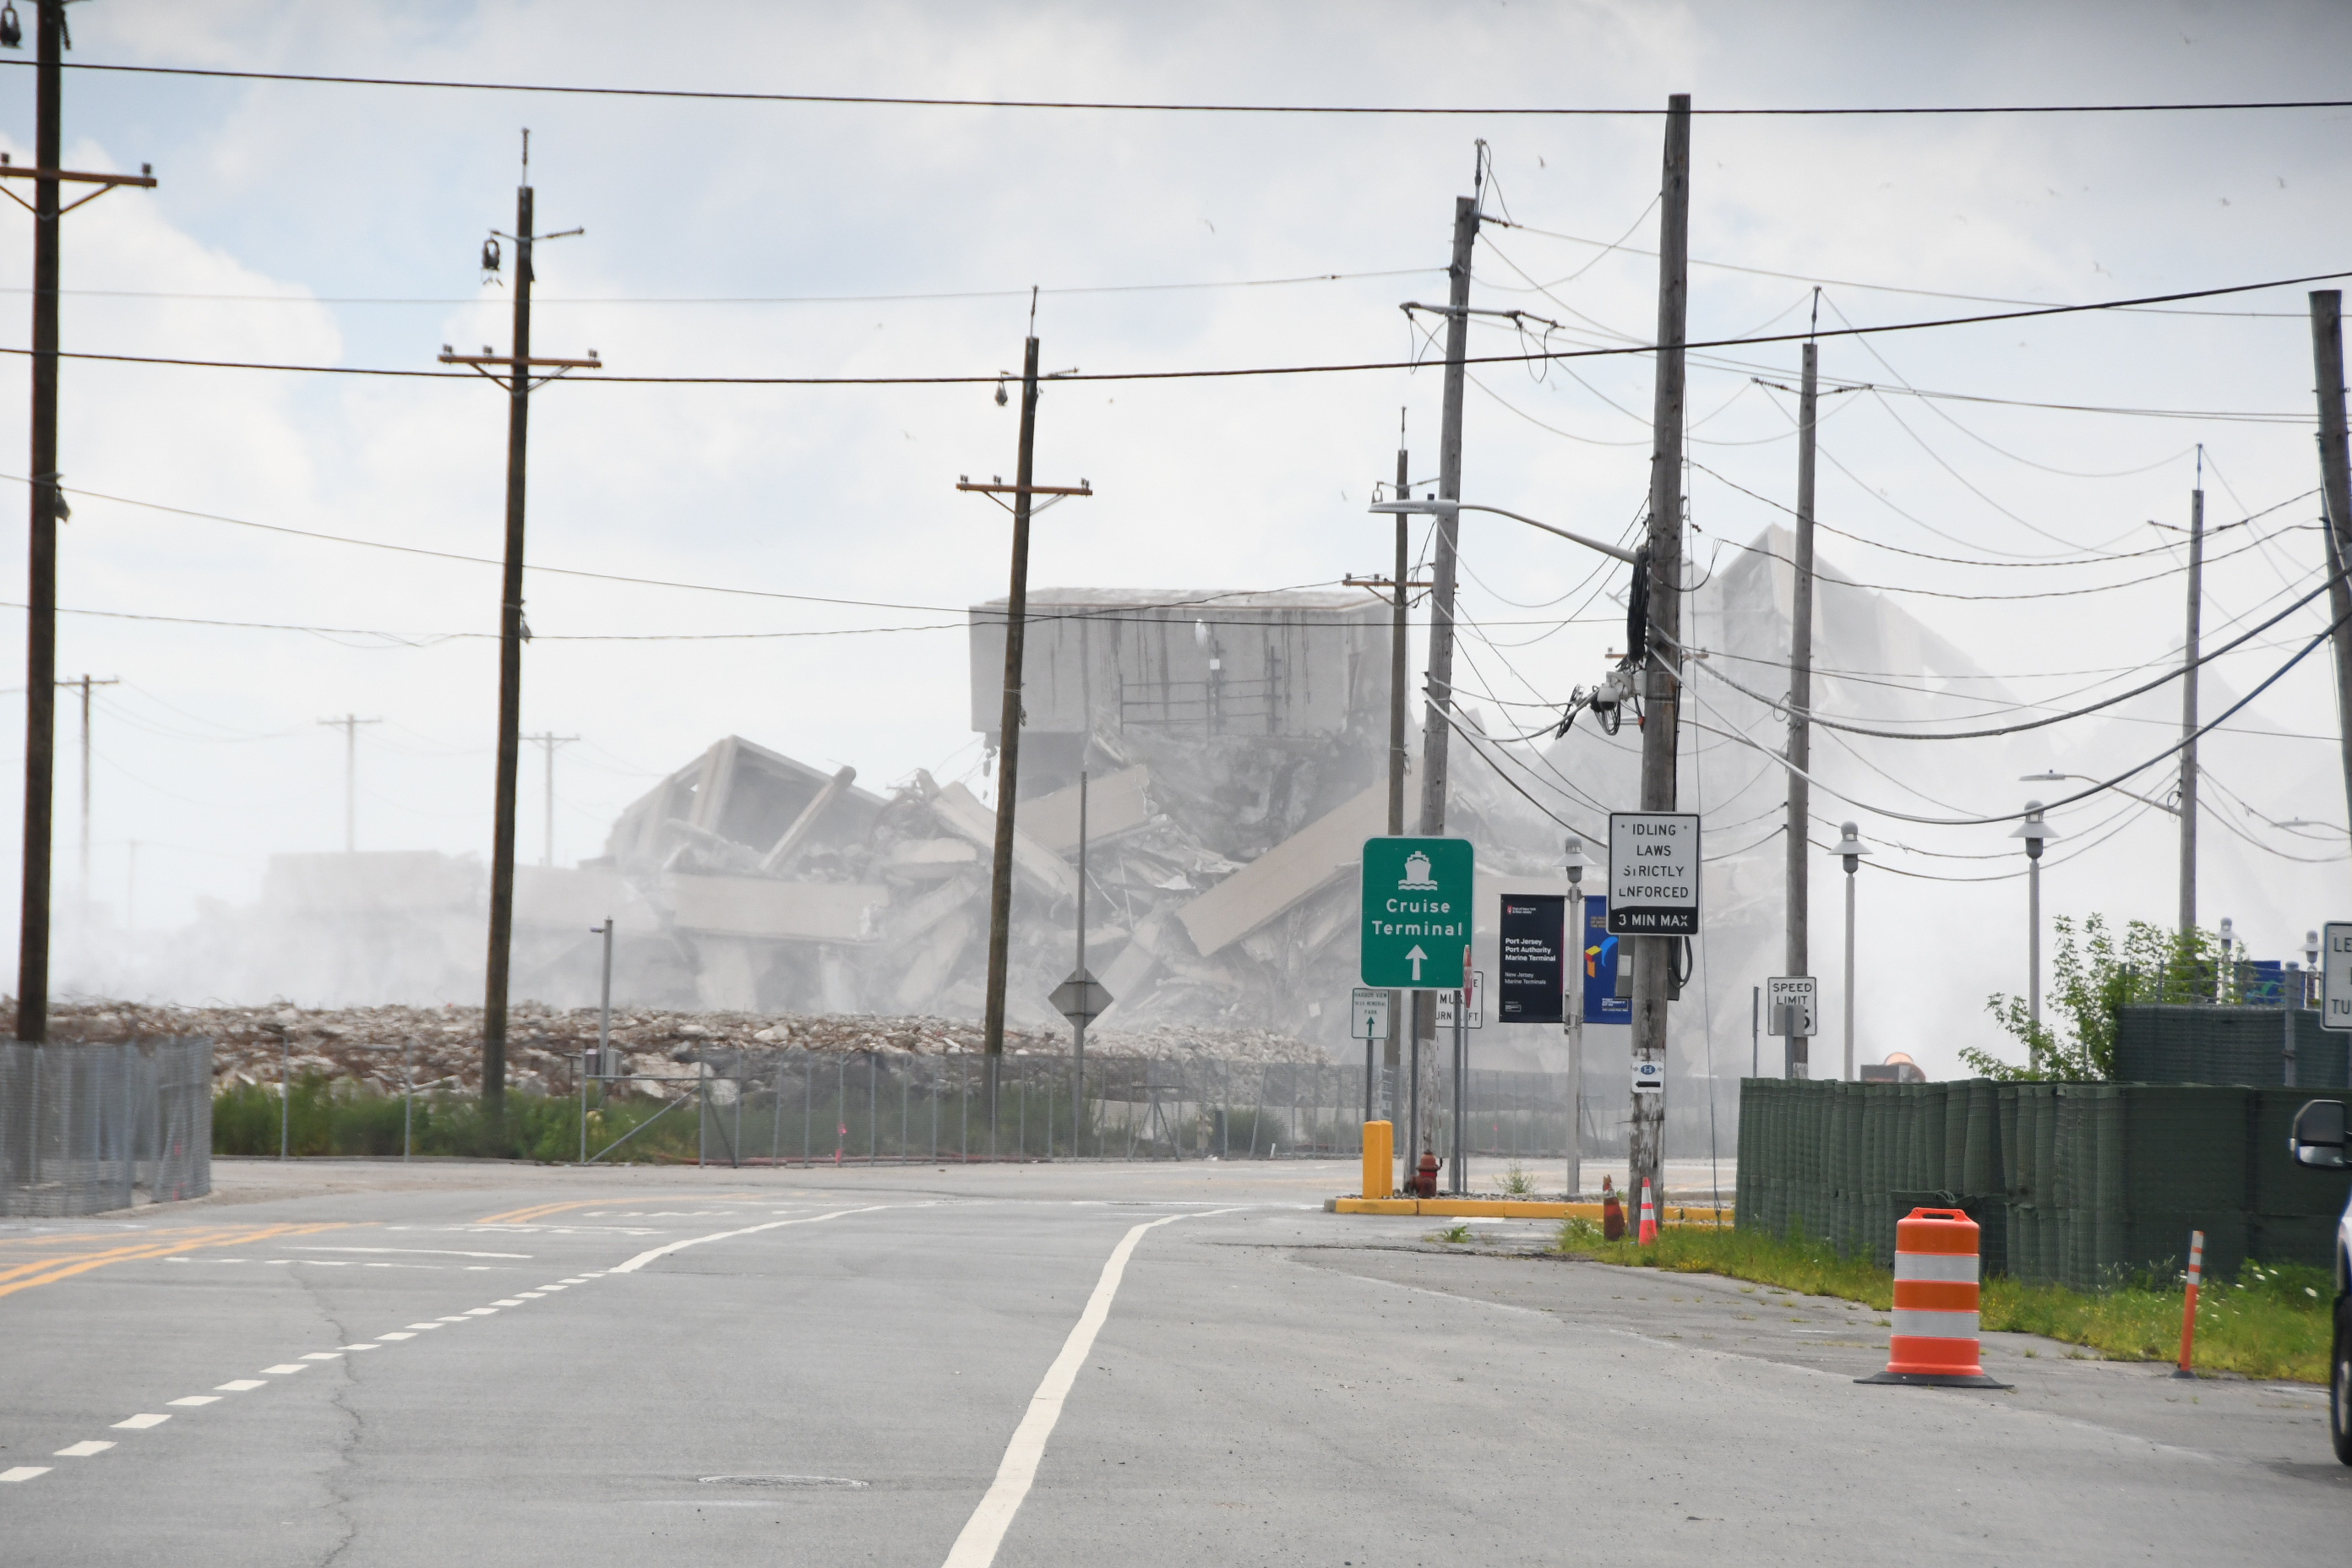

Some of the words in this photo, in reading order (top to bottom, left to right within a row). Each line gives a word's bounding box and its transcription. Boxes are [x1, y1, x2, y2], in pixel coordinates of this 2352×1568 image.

[1632, 824, 1676, 836] IDLING
[1636, 845, 1672, 856] LAWS
[1386, 898, 1451, 913] Cruise
[1618, 914, 1627, 926] 3
[1631, 914, 1656, 926] MIN
[1660, 915, 1688, 927] MAX
[1371, 920, 1462, 936] Terminal
[1521, 938, 1543, 946] Jersey
[2333, 937, 2352, 952] LE
[1521, 946, 1551, 955] Authority
[1772, 983, 1812, 993] SPEED
[1776, 995, 1808, 1004] LIMIT
